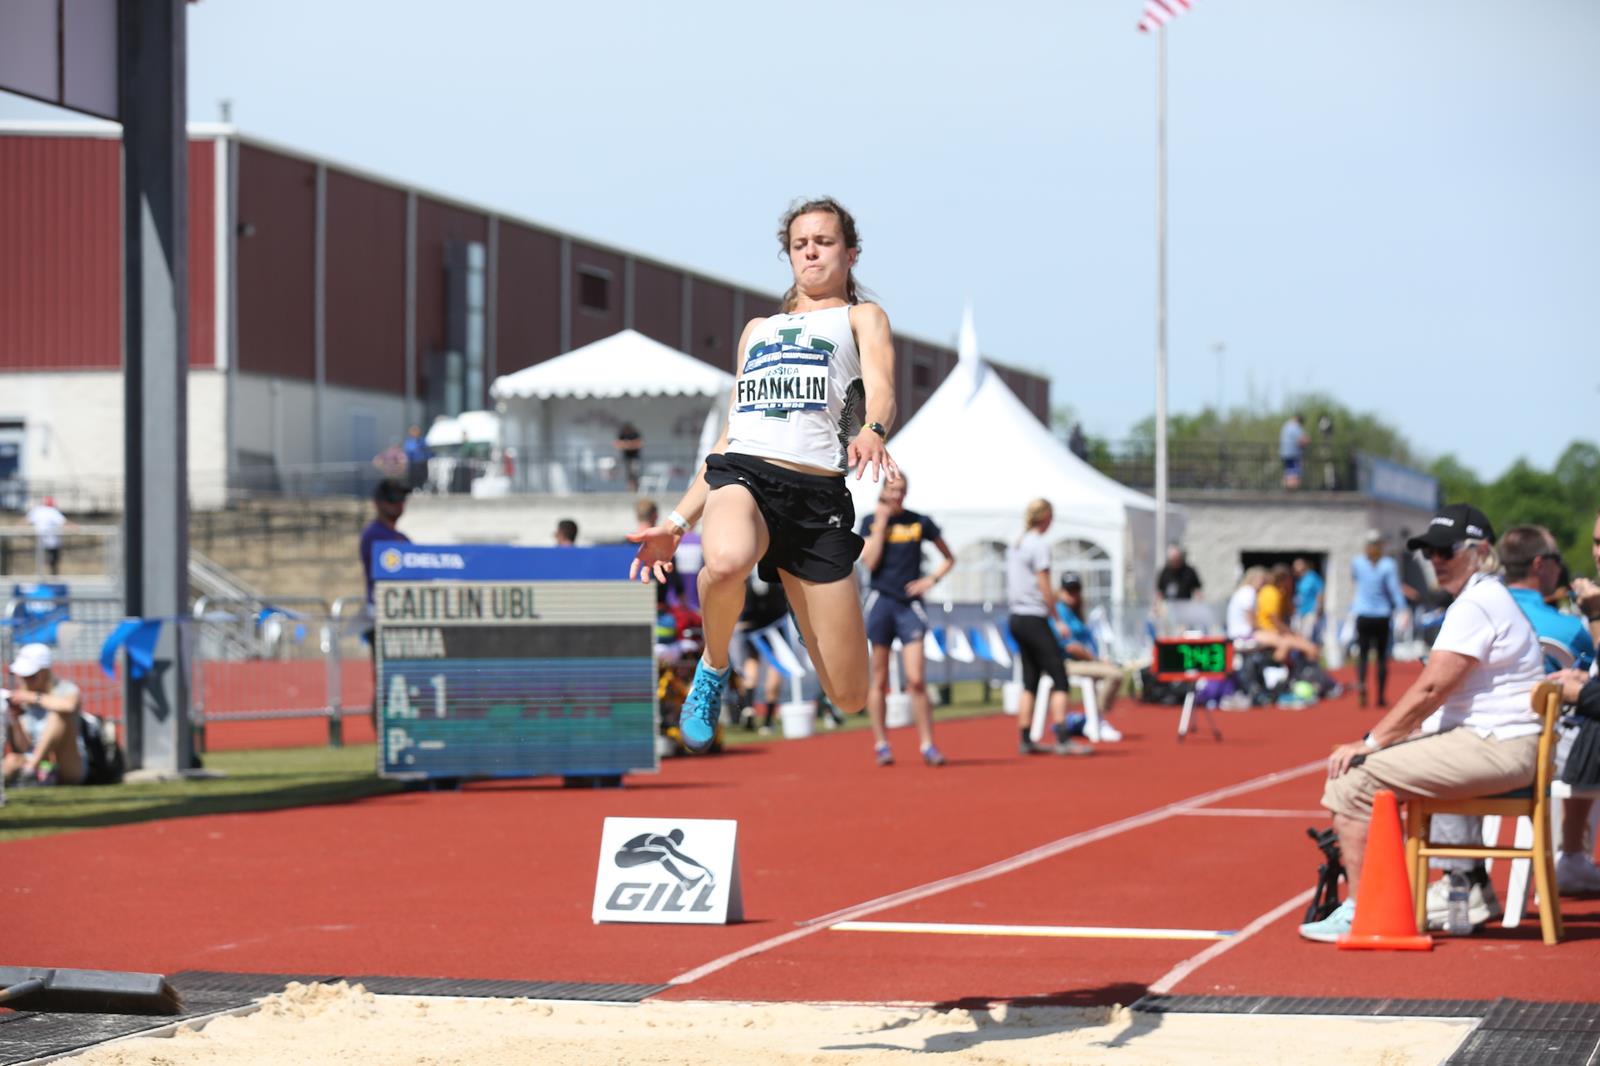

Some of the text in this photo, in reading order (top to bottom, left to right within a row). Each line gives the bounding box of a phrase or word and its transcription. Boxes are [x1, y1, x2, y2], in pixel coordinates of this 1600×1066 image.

[737, 376, 826, 403] FRANKLIN
[403, 552, 465, 570] DELTA
[383, 586, 540, 620] CAITLIN UBL
[605, 882, 717, 912] GILL
